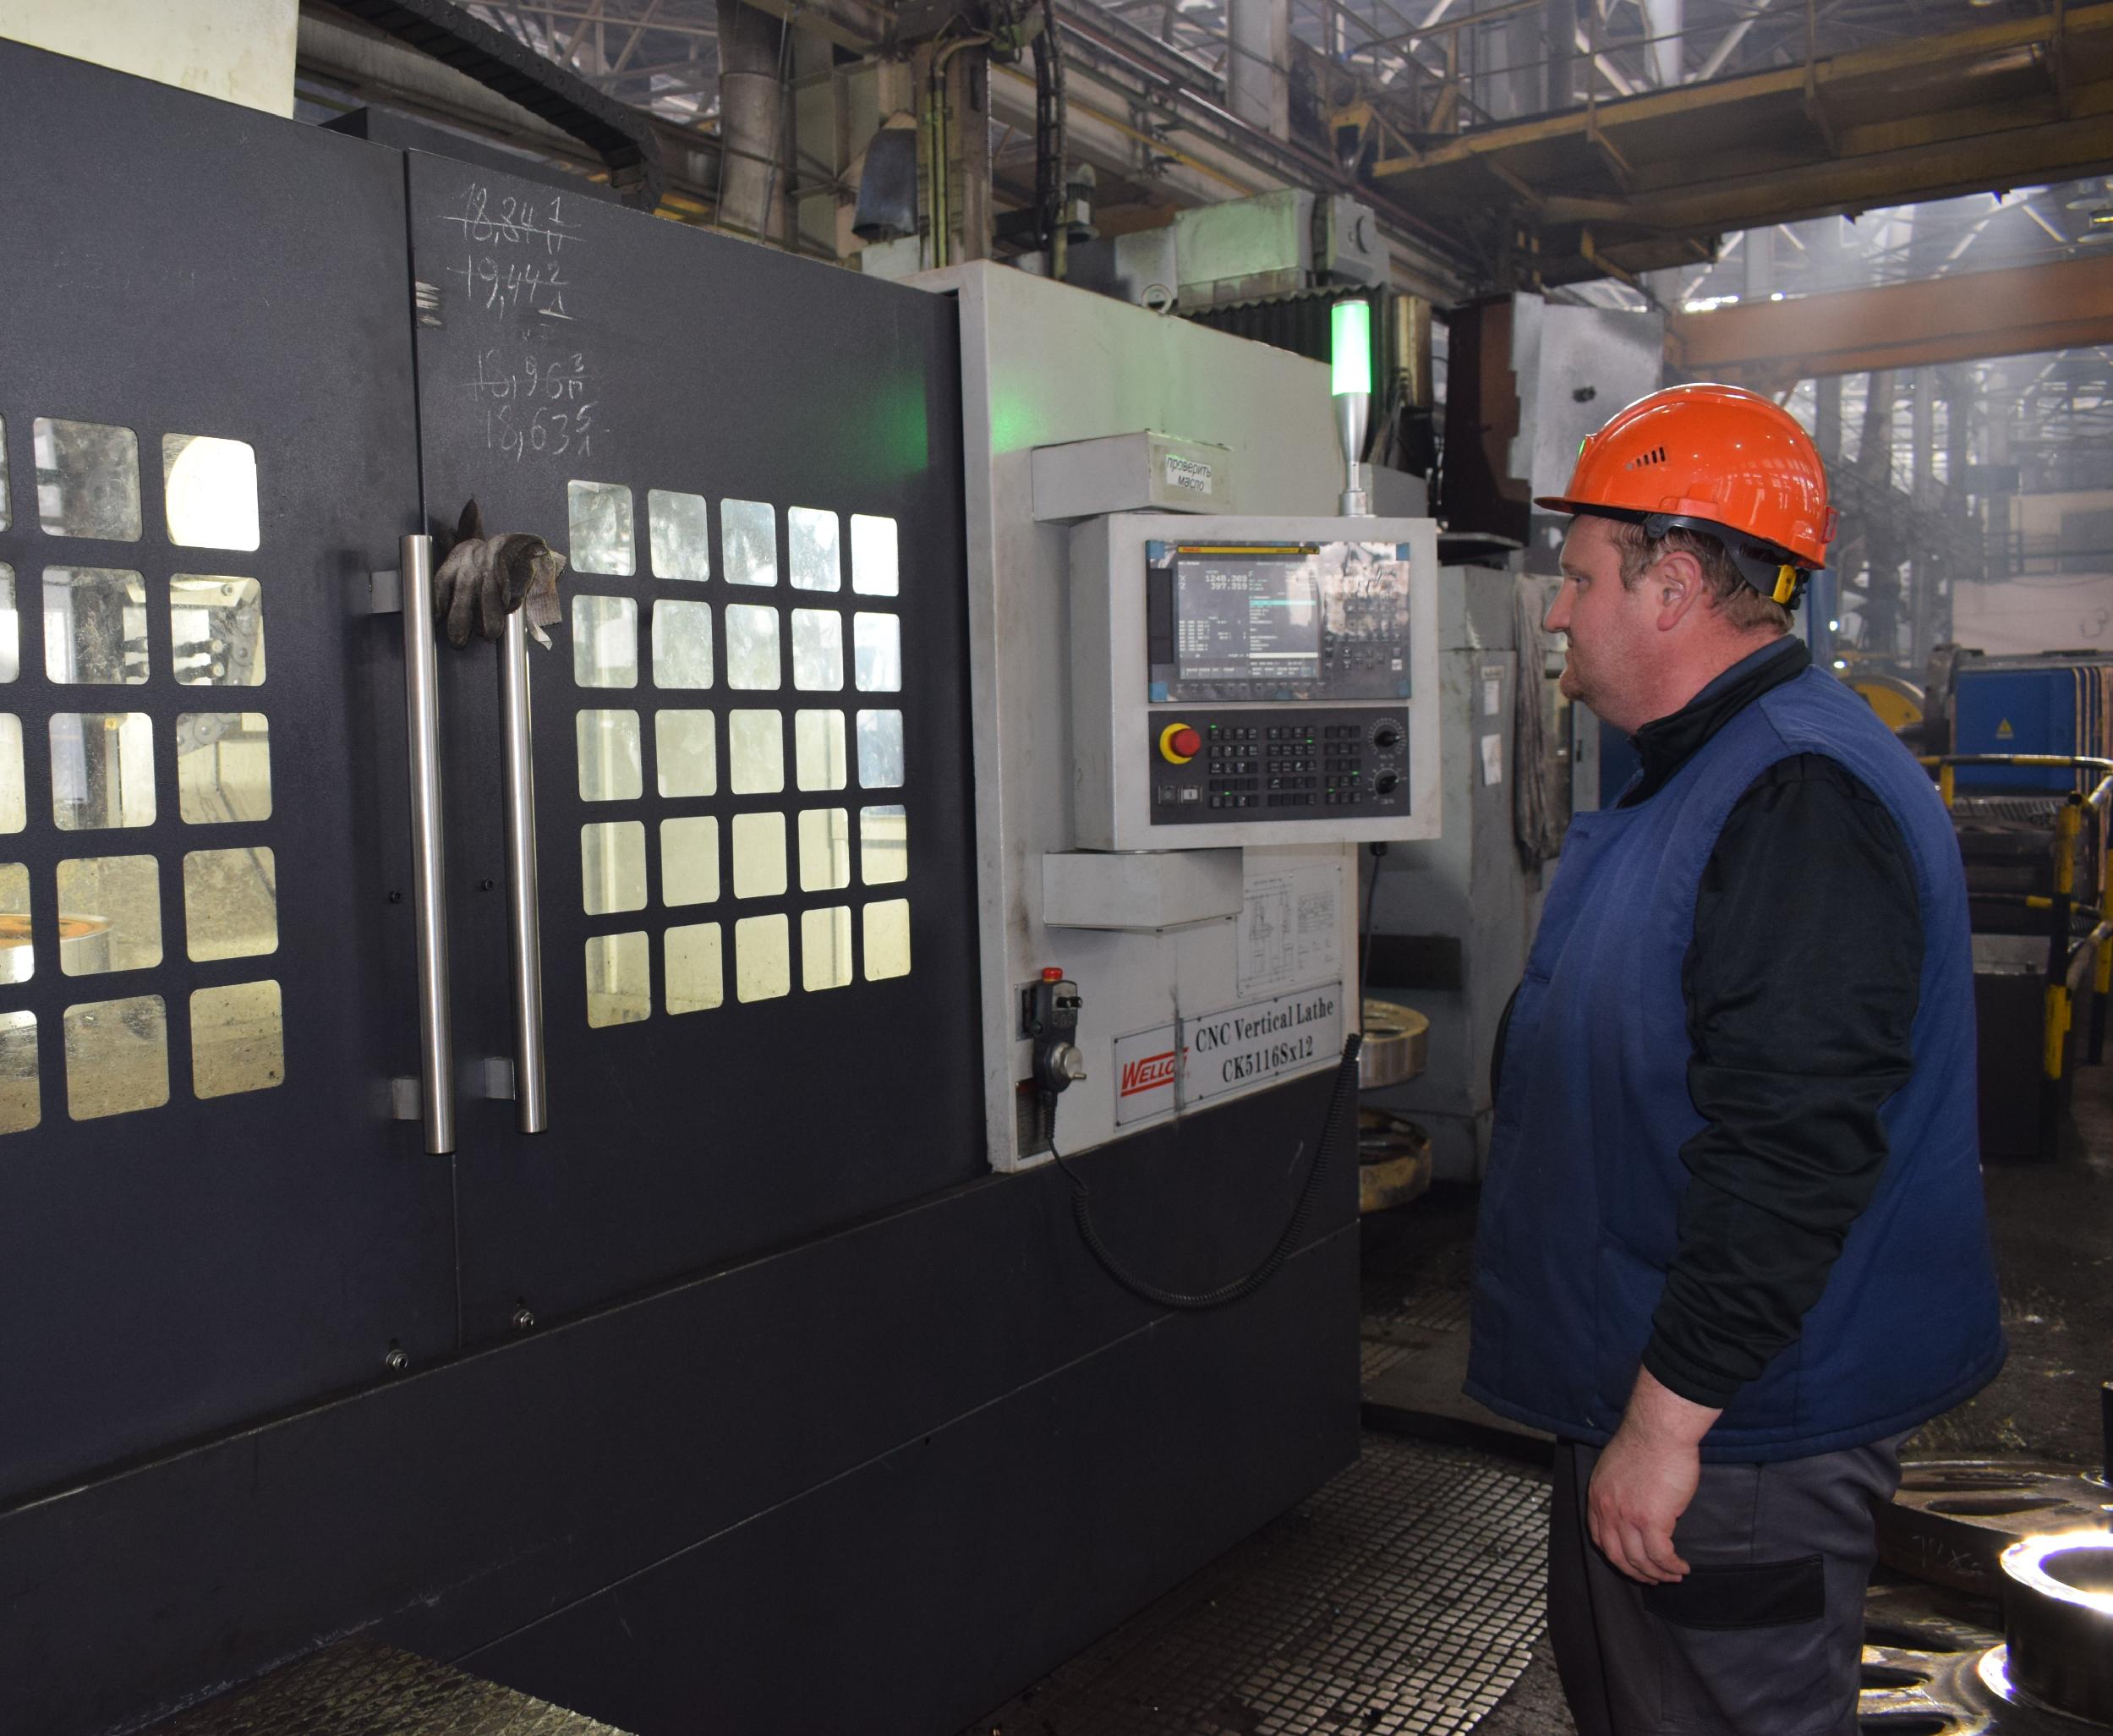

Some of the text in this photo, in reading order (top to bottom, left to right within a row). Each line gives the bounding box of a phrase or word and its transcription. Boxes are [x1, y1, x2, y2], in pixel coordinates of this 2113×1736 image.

[1167, 457, 1211, 478] проверить
[1178, 475, 1205, 491] масло
[1195, 997, 1334, 1053] CNC Vertical Lathe
[1223, 1035, 1314, 1083] CK5116Sx12
